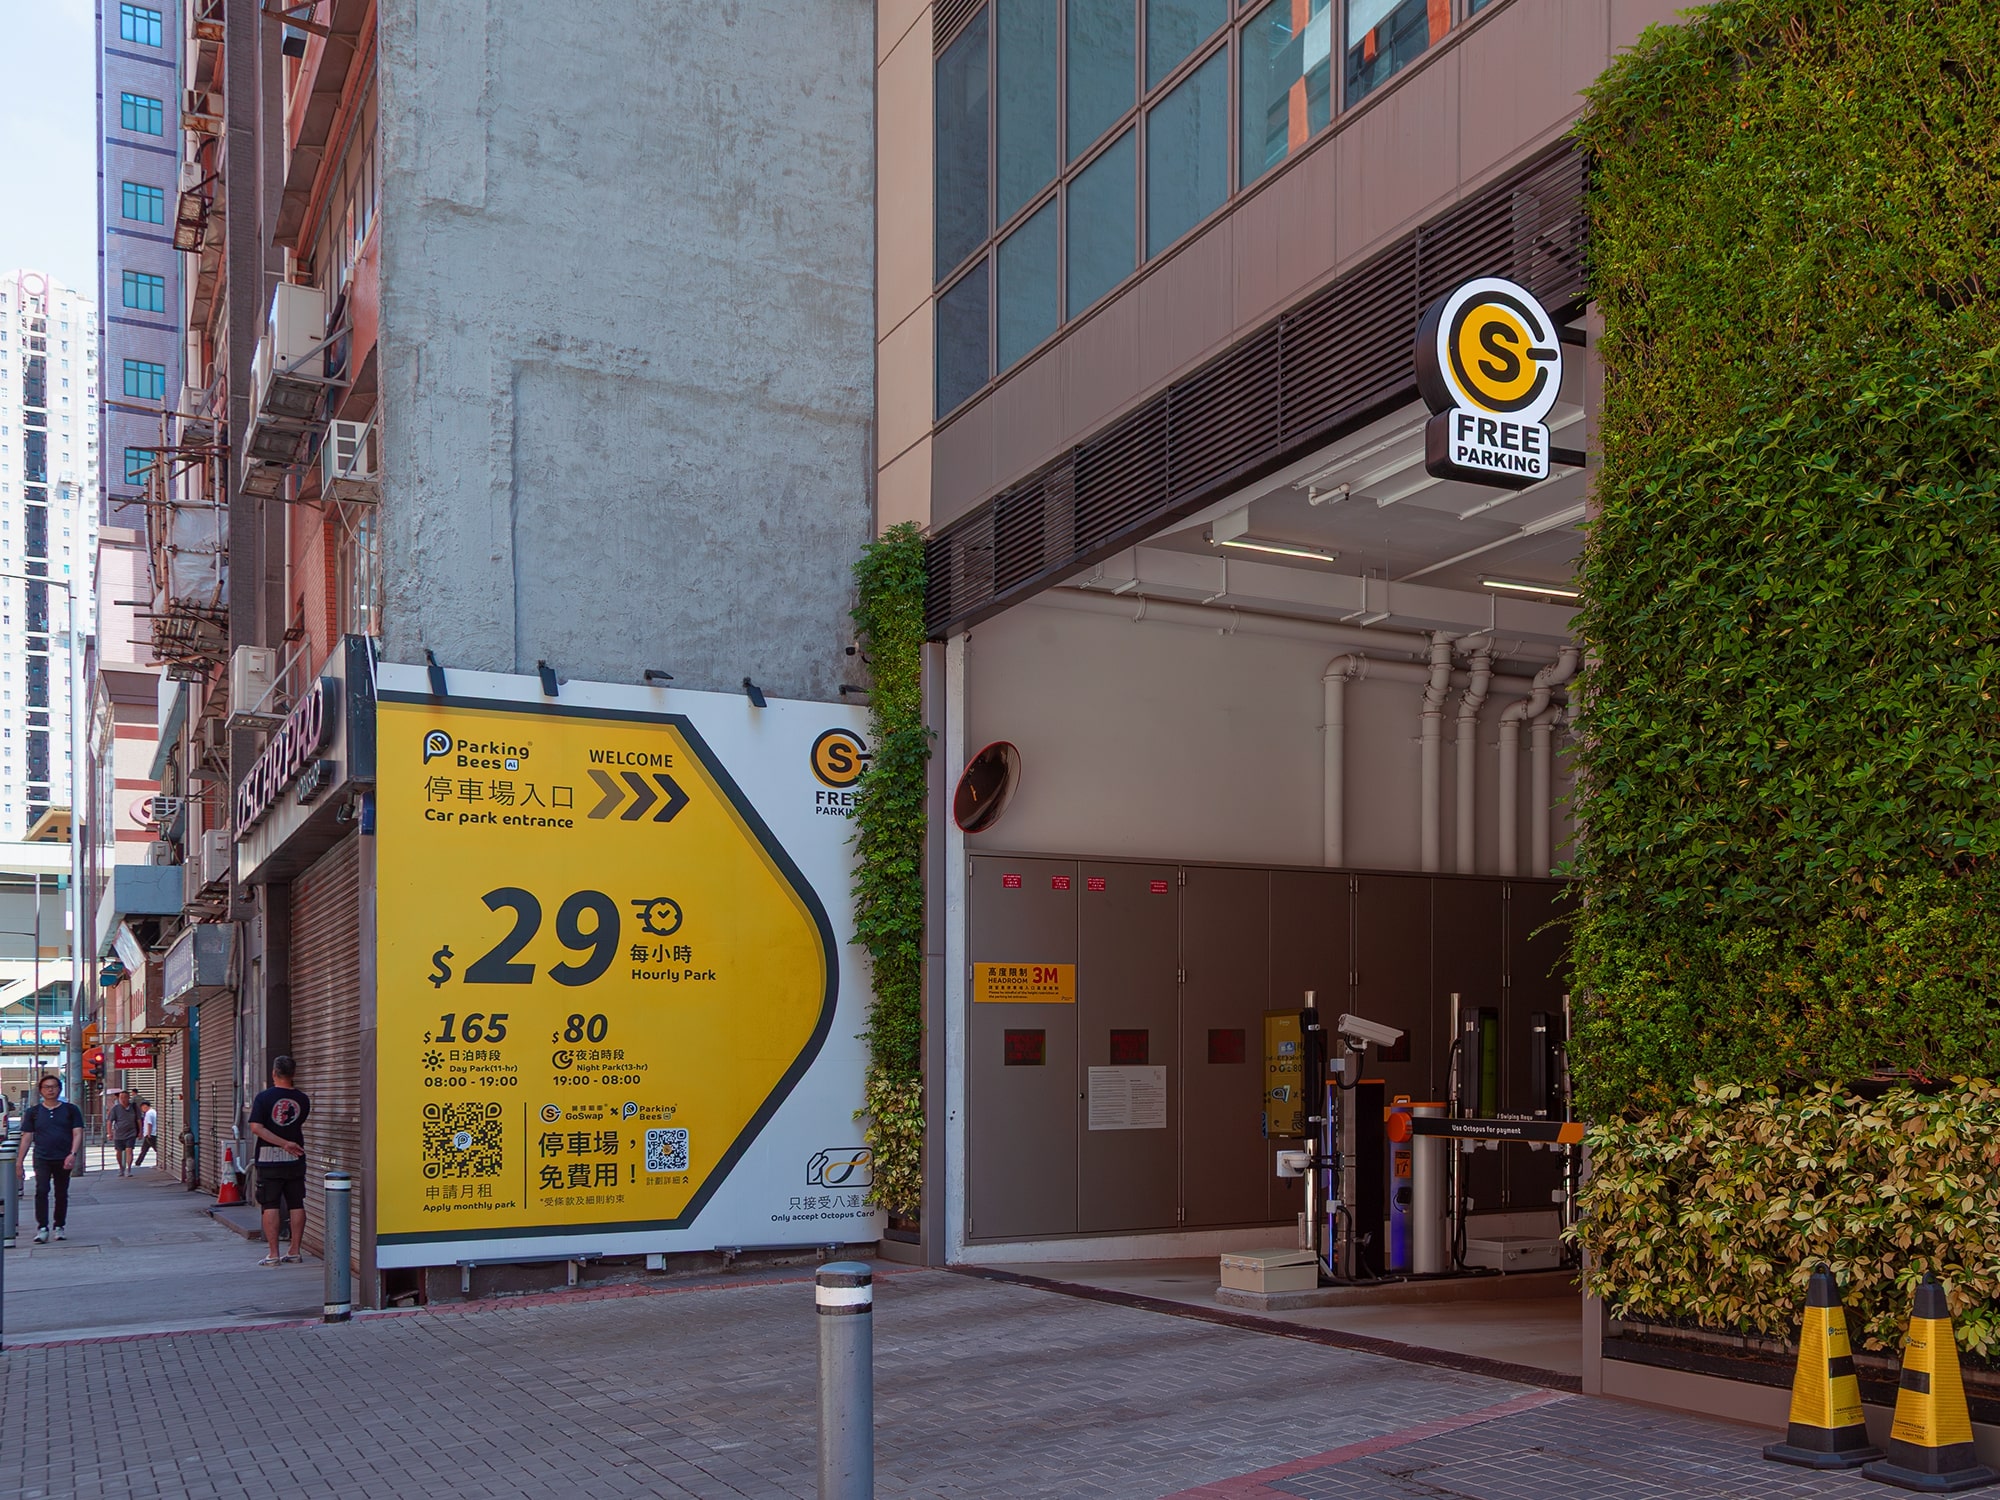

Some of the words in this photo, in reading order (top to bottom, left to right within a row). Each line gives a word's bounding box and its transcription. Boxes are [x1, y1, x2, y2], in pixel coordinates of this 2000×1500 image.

[1457, 414, 1541, 454] FREE
[1457, 445, 1541, 474] PARKING
[457, 740, 530, 760] Parking
[457, 755, 501, 769] Bees
[589, 749, 674, 768] WELCOME
[424, 775, 574, 809] 停車場入口
[425, 808, 454, 822] Car
[459, 811, 498, 825] park
[502, 814, 574, 828] entrance
[630, 943, 692, 964] 每小時
[631, 969, 680, 983] Hourly
[684, 970, 717, 981] Park
[1032, 967, 1058, 984] 3M
[423, 1013, 509, 1044] $165
[552, 1013, 608, 1044] $80
[449, 1049, 501, 1061] 日泊時段
[576, 1049, 625, 1061] 夜泊時段
[450, 1065, 467, 1073] Day
[470, 1064, 518, 1072] Park(11-hr)
[576, 1064, 600, 1072] Night
[602, 1063, 648, 1071] Park(13-hr)
[424, 1077, 467, 1087] 08:00
[479, 1076, 518, 1086] 19:00
[553, 1075, 590, 1085] 19:00
[602, 1074, 641, 1084] 08:00
[639, 1104, 676, 1113] Parking
[565, 1112, 604, 1121] GoSwap
[1451, 1124, 1462, 1132] Use
[1463, 1124, 1486, 1133] Octopus
[1486, 1125, 1496, 1133] for
[1496, 1126, 1521, 1135] payment
[425, 1183, 493, 1200] 申請月租
[423, 1203, 451, 1212] Apply
[453, 1201, 492, 1211] monthly
[494, 1200, 516, 1209] park
[771, 1214, 790, 1222] Only
[792, 1212, 818, 1221] accept
[820, 1211, 854, 1220] Octopus
[856, 1210, 875, 1218] Card
